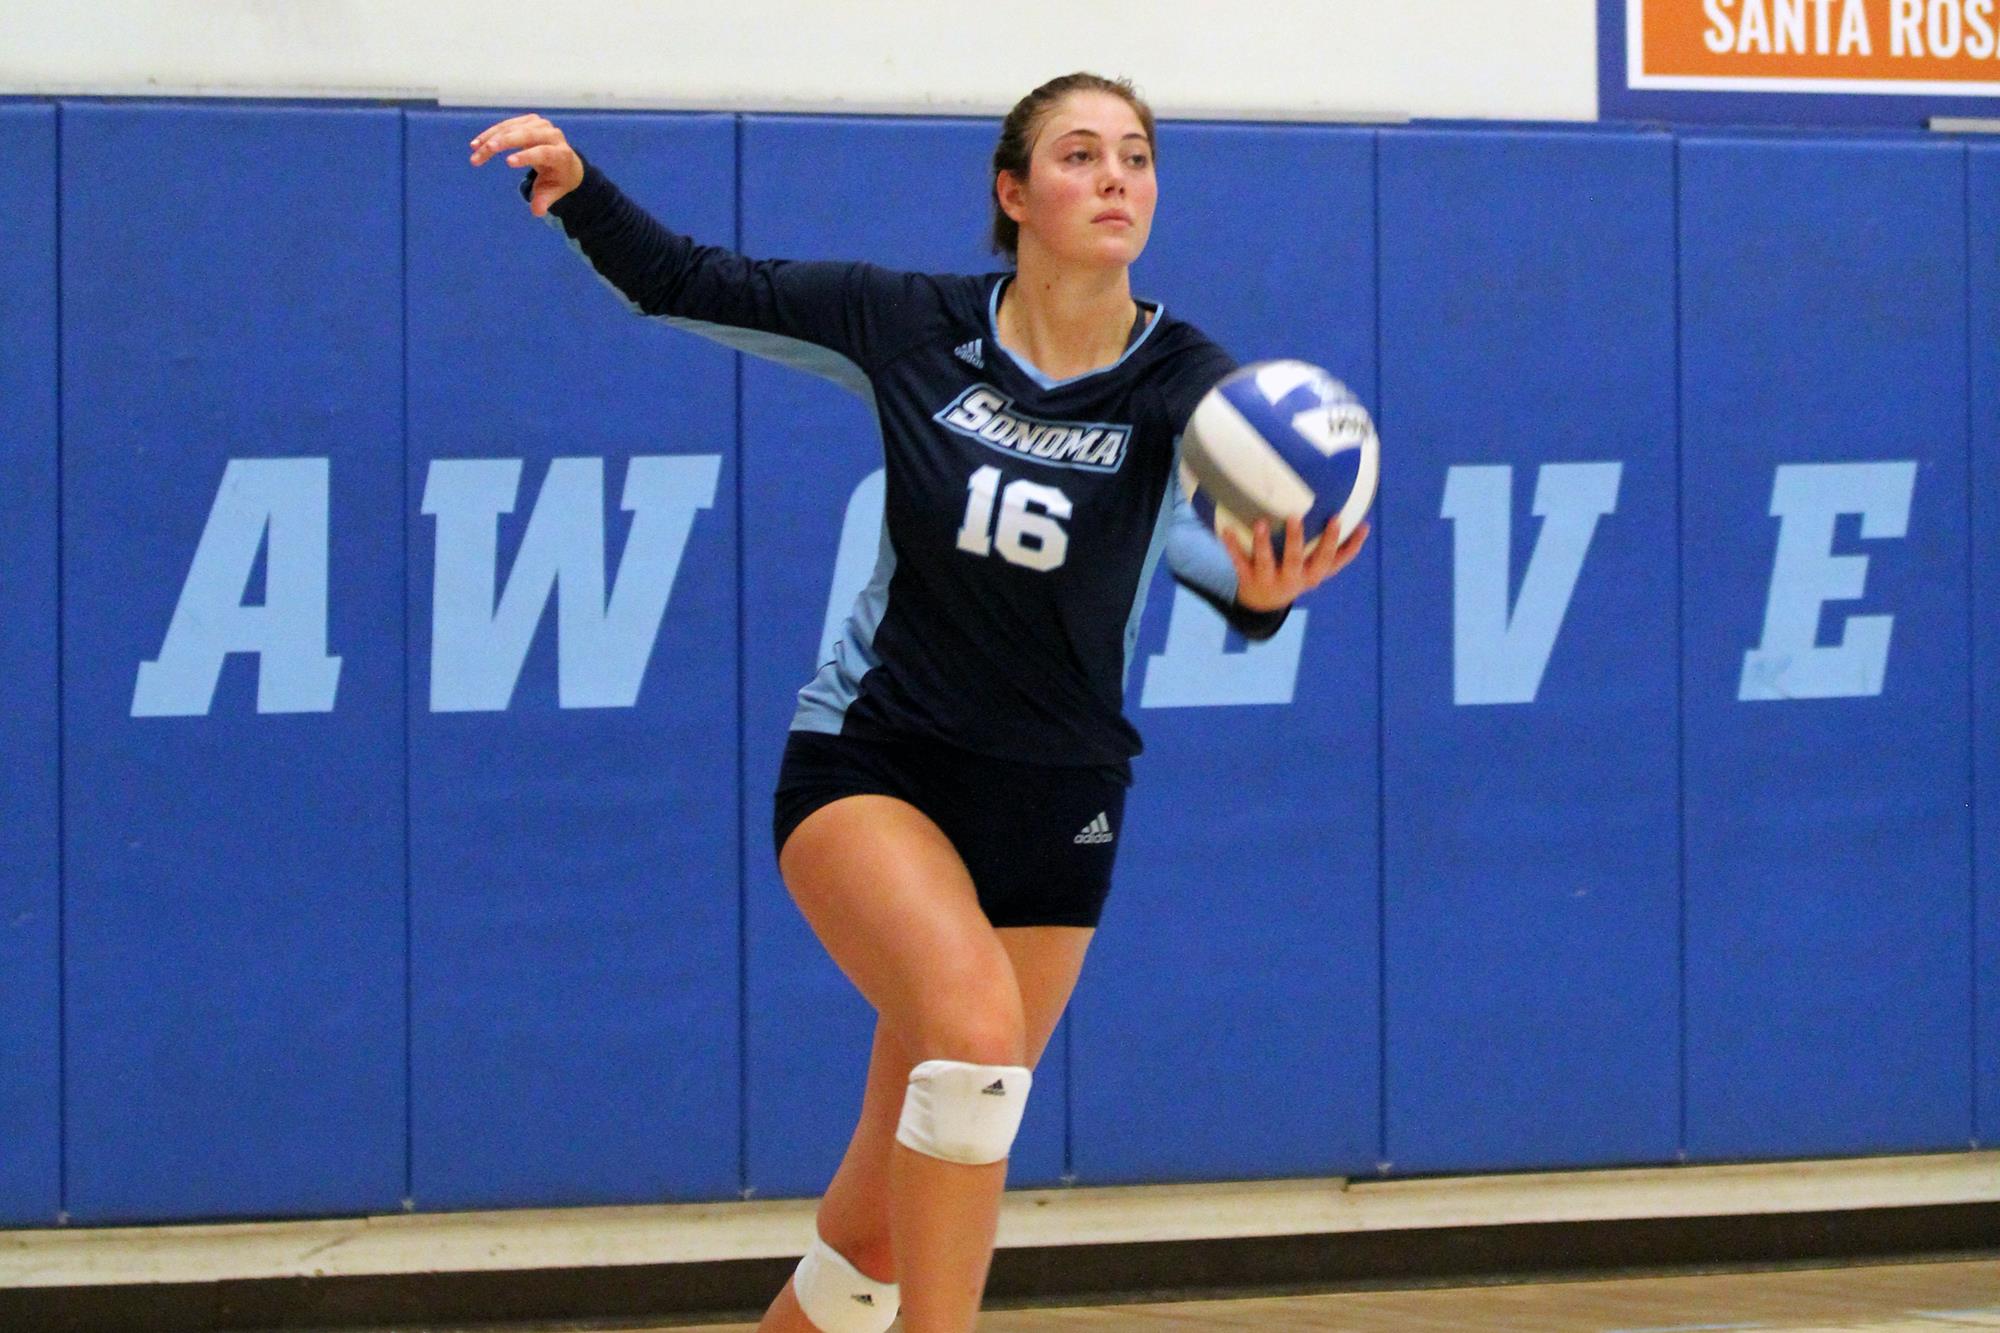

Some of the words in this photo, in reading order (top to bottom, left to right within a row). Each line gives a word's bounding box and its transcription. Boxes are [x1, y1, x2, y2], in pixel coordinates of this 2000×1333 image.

[1703, 0, 1872, 56] SANTA
[1890, 0, 2000, 59] ROS
[943, 388, 1126, 467] SONOMA
[956, 464, 1074, 572] 16
[129, 454, 1918, 717] AWVE
